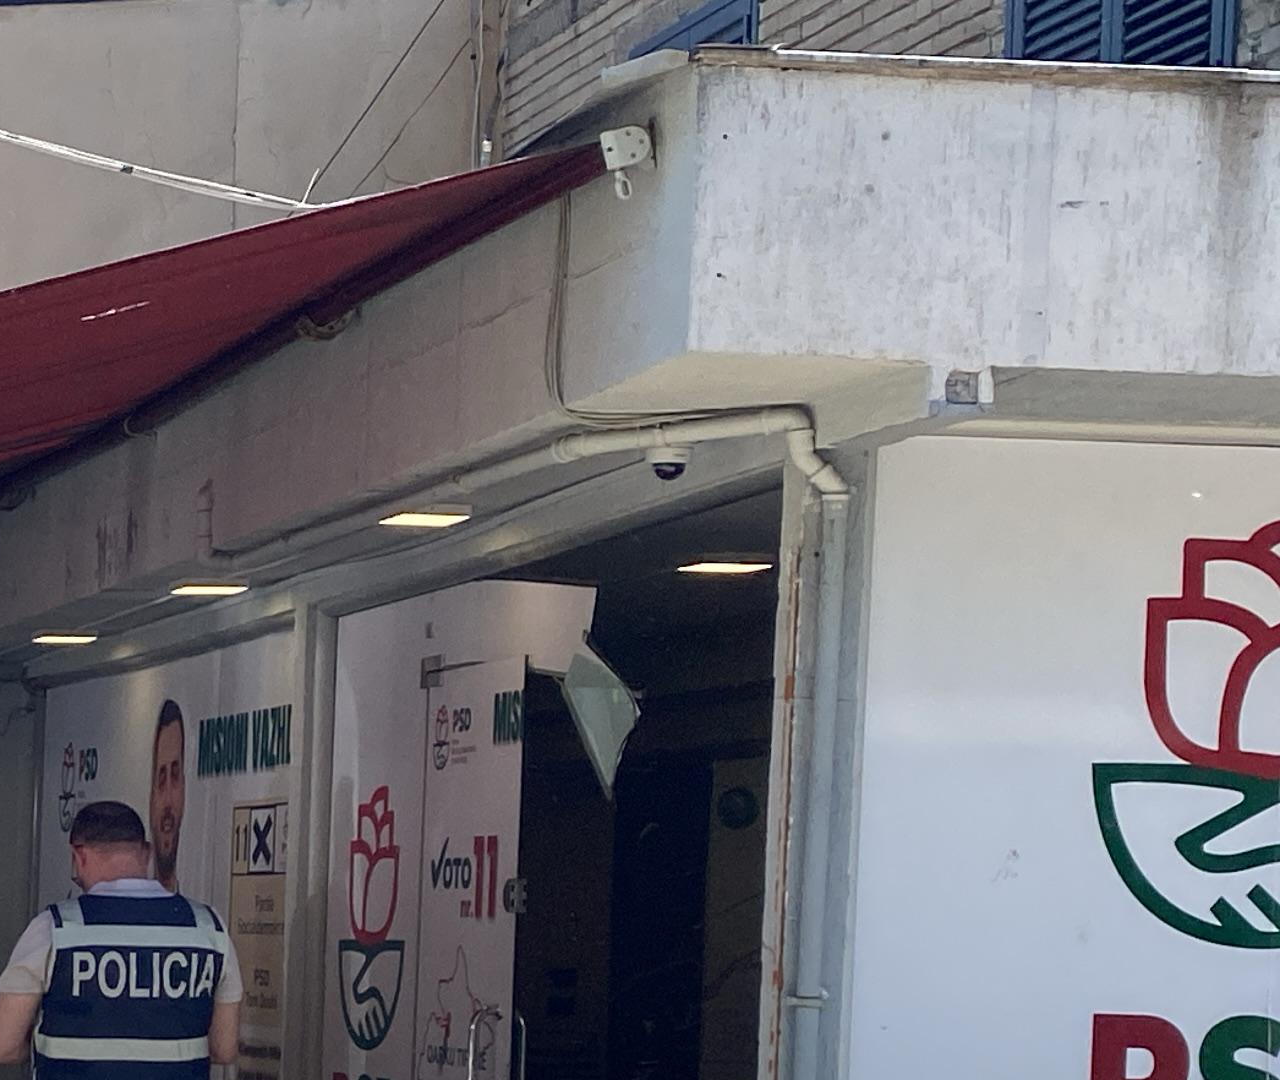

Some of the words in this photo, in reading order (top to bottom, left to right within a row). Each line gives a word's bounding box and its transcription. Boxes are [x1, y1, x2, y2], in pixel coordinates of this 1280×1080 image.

[452, 707, 472, 734] PSD
[473, 834, 499, 920] 11
[71, 950, 215, 999] POLICIA
